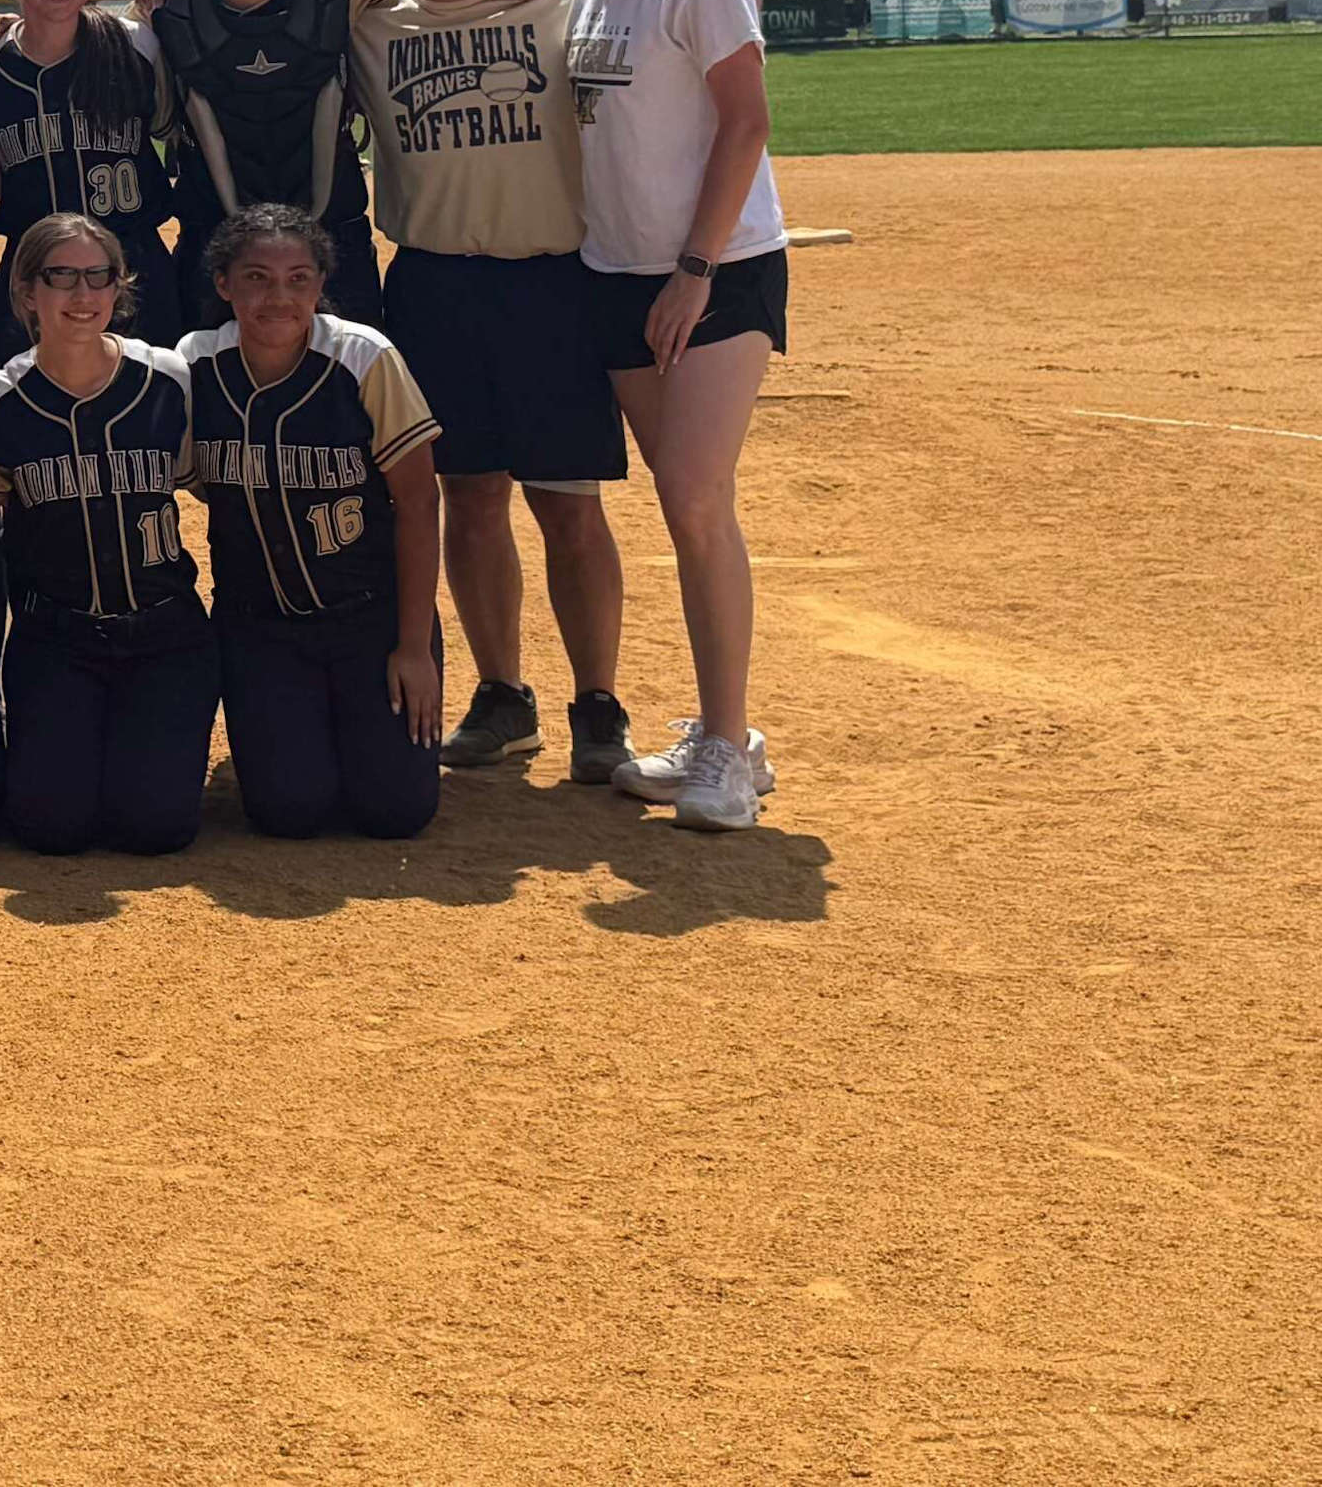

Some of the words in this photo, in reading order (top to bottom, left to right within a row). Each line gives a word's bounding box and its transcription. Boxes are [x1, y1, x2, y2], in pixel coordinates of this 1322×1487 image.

[388, 30, 465, 92] INDIAN
[469, 24, 542, 77] HILLS
[412, 69, 478, 113] BRAVES
[394, 102, 542, 153] SOFTBALL
[87, 158, 142, 216] 30
[277, 444, 368, 491] HILLS
[137, 502, 181, 567] 10
[306, 496, 364, 556] 16
